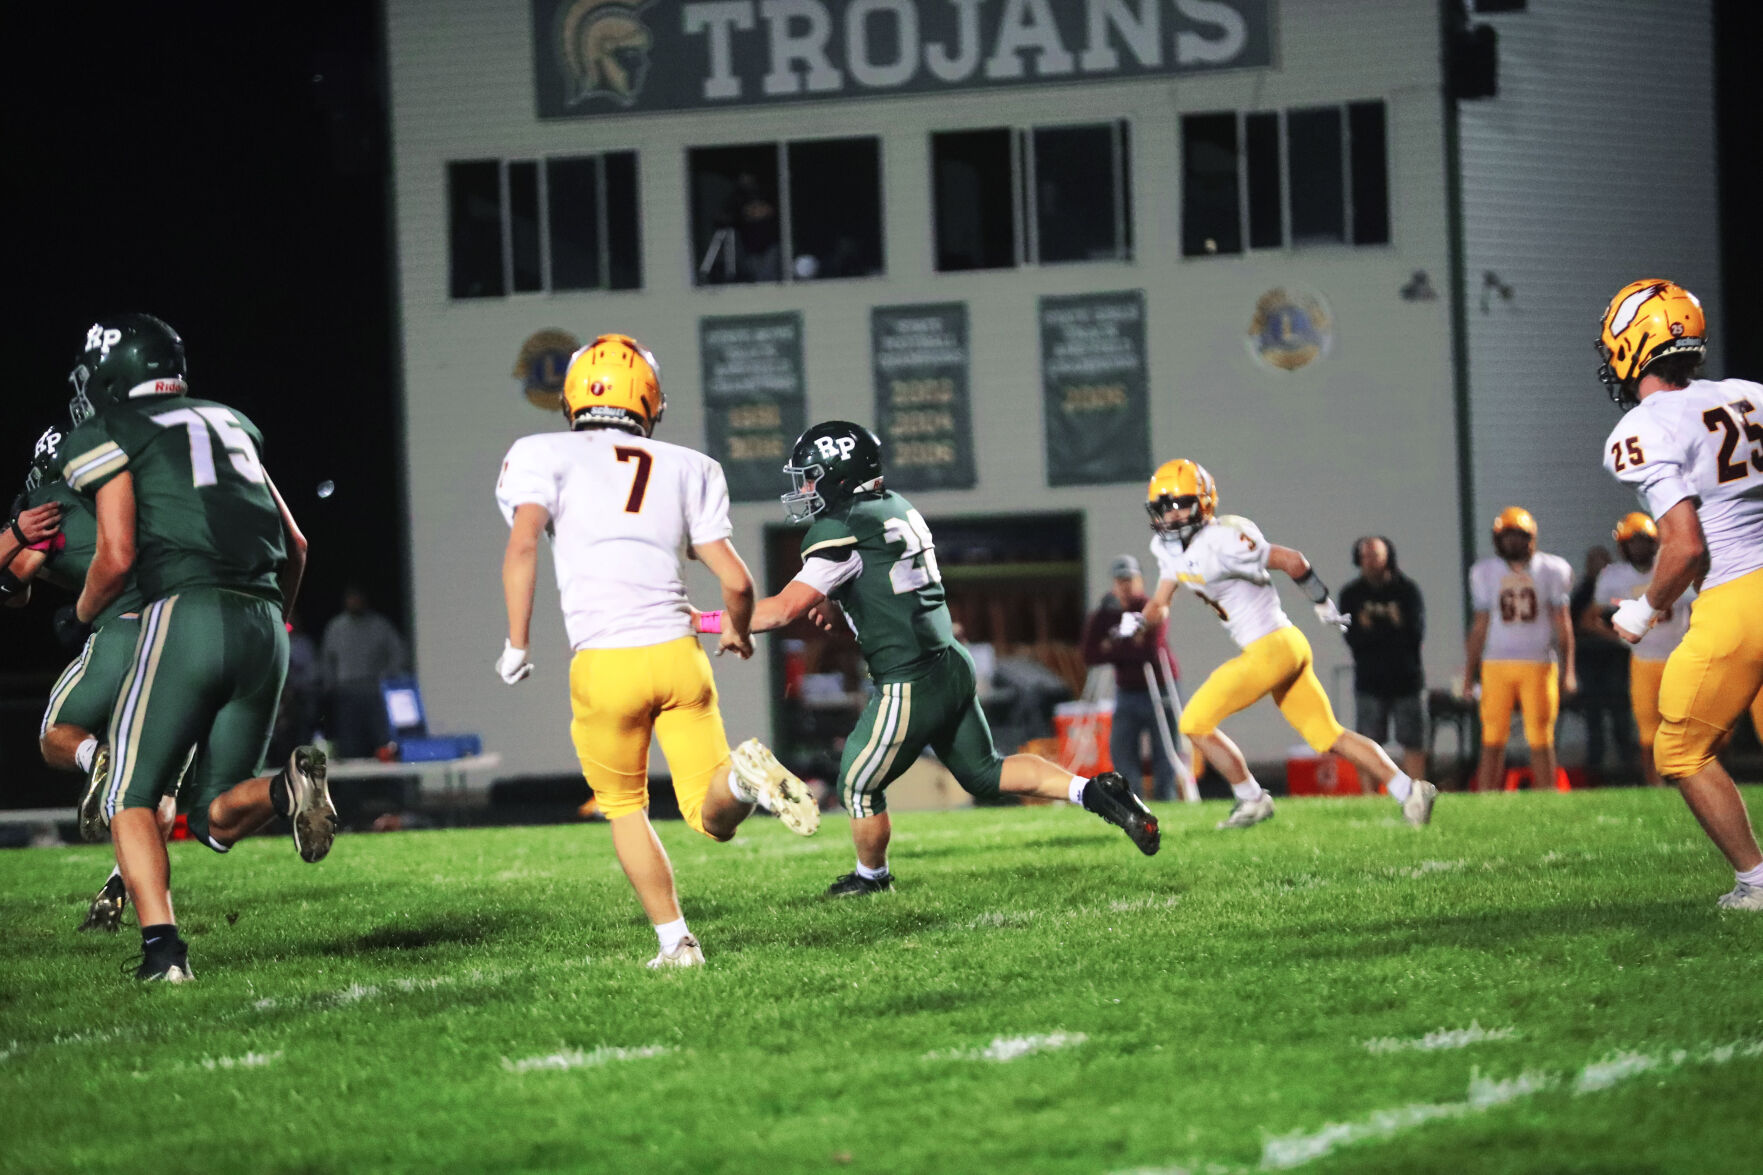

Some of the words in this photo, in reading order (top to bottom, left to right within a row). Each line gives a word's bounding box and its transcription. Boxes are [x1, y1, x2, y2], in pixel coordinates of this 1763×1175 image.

[683, 0, 1247, 98] TROJANS
[1671, 324, 1684, 335] 25
[149, 406, 266, 488] 75
[814, 435, 855, 461] RP
[1610, 436, 1646, 473] 25
[1702, 398, 1763, 485] 25
[613, 445, 653, 514] 7
[1239, 532, 1257, 552] 3
